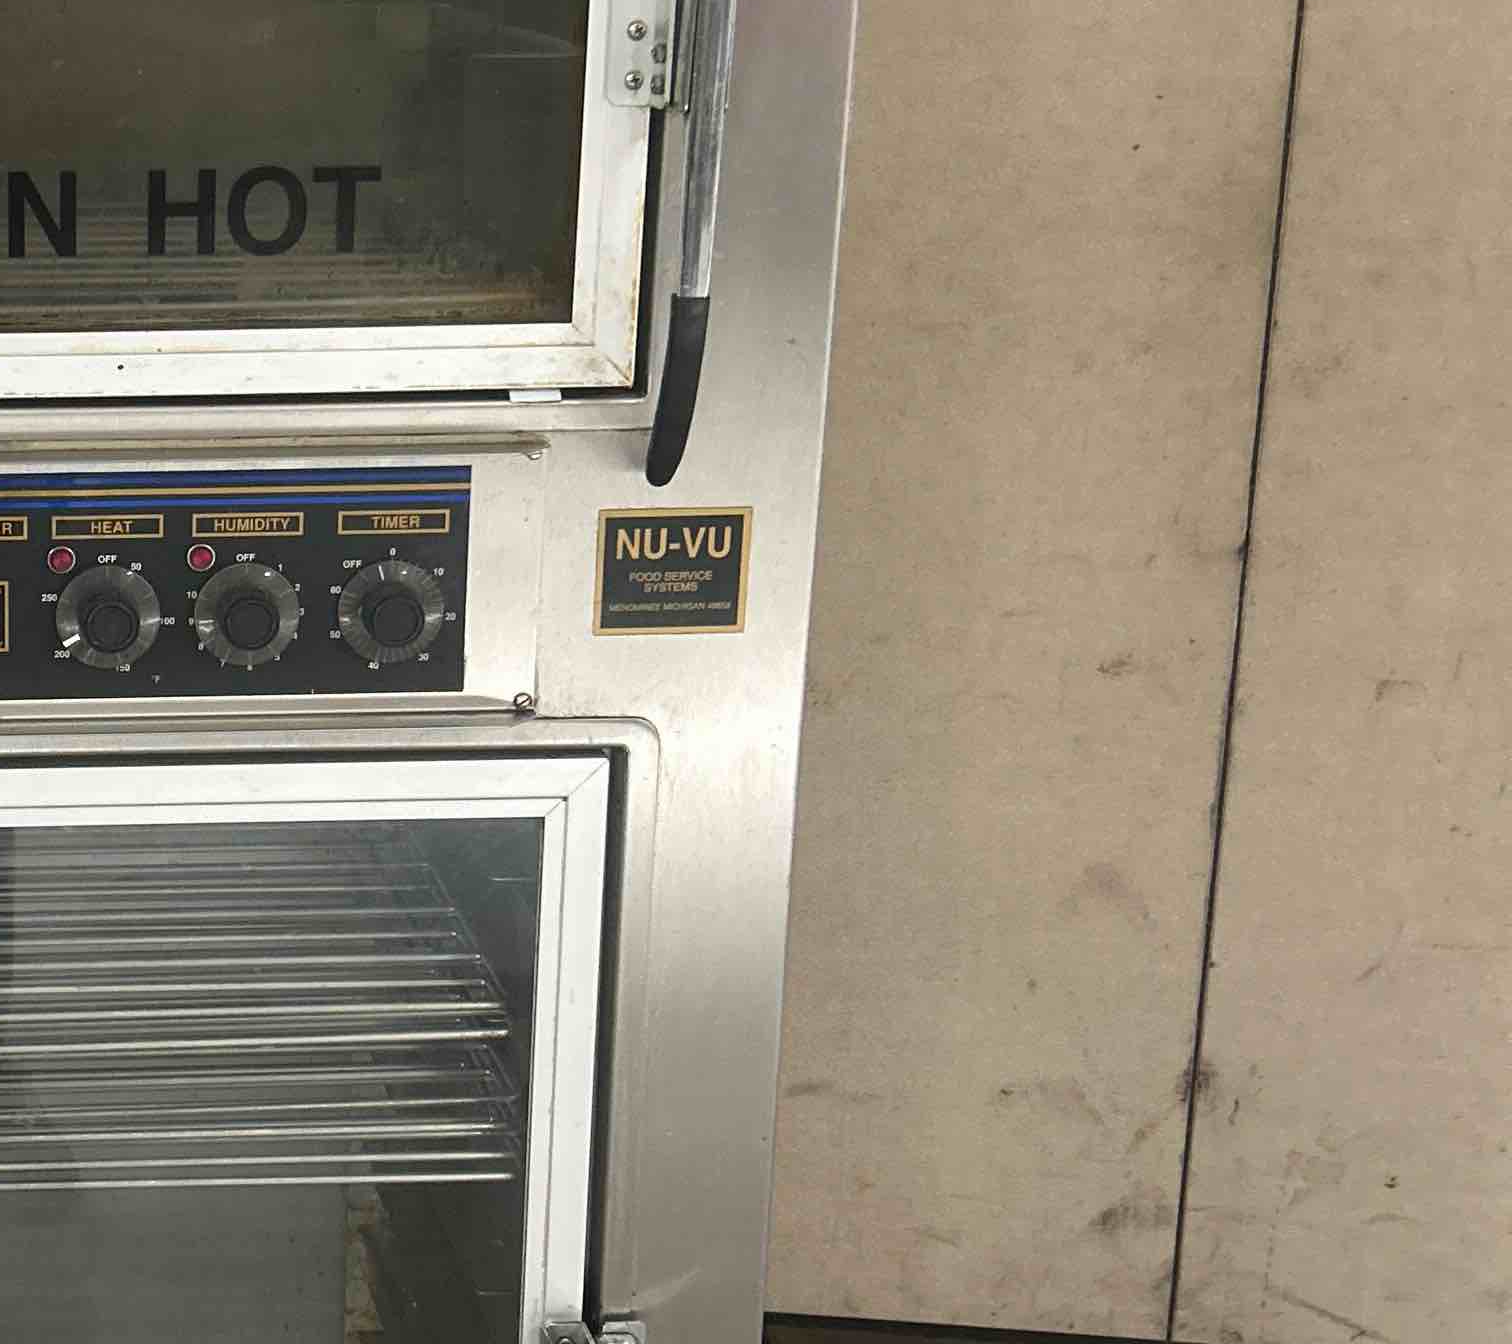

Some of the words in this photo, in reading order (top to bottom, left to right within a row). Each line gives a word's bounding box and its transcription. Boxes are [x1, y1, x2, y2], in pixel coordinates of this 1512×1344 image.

[146, 164, 383, 256] HOT
[214, 517, 290, 532] HUMIDITY
[371, 516, 421, 529] TIMER
[90, 521, 133, 535] HEAT
[616, 527, 732, 560] NU-VU
[389, 547, 396, 556] 0
[97, 555, 117, 564] OFF
[236, 553, 256, 562] OFF
[131, 562, 142, 572] 50
[277, 563, 283, 572] 1
[342, 559, 362, 569] OFF
[433, 567, 445, 576] 10
[629, 571, 662, 582] FOOD
[664, 570, 713, 582] SERVICE
[643, 582, 698, 592] SYSTEMS
[41, 593, 58, 602] 250
[186, 590, 198, 599] 10
[445, 612, 456, 621] 20
[54, 650, 70, 659] 200
